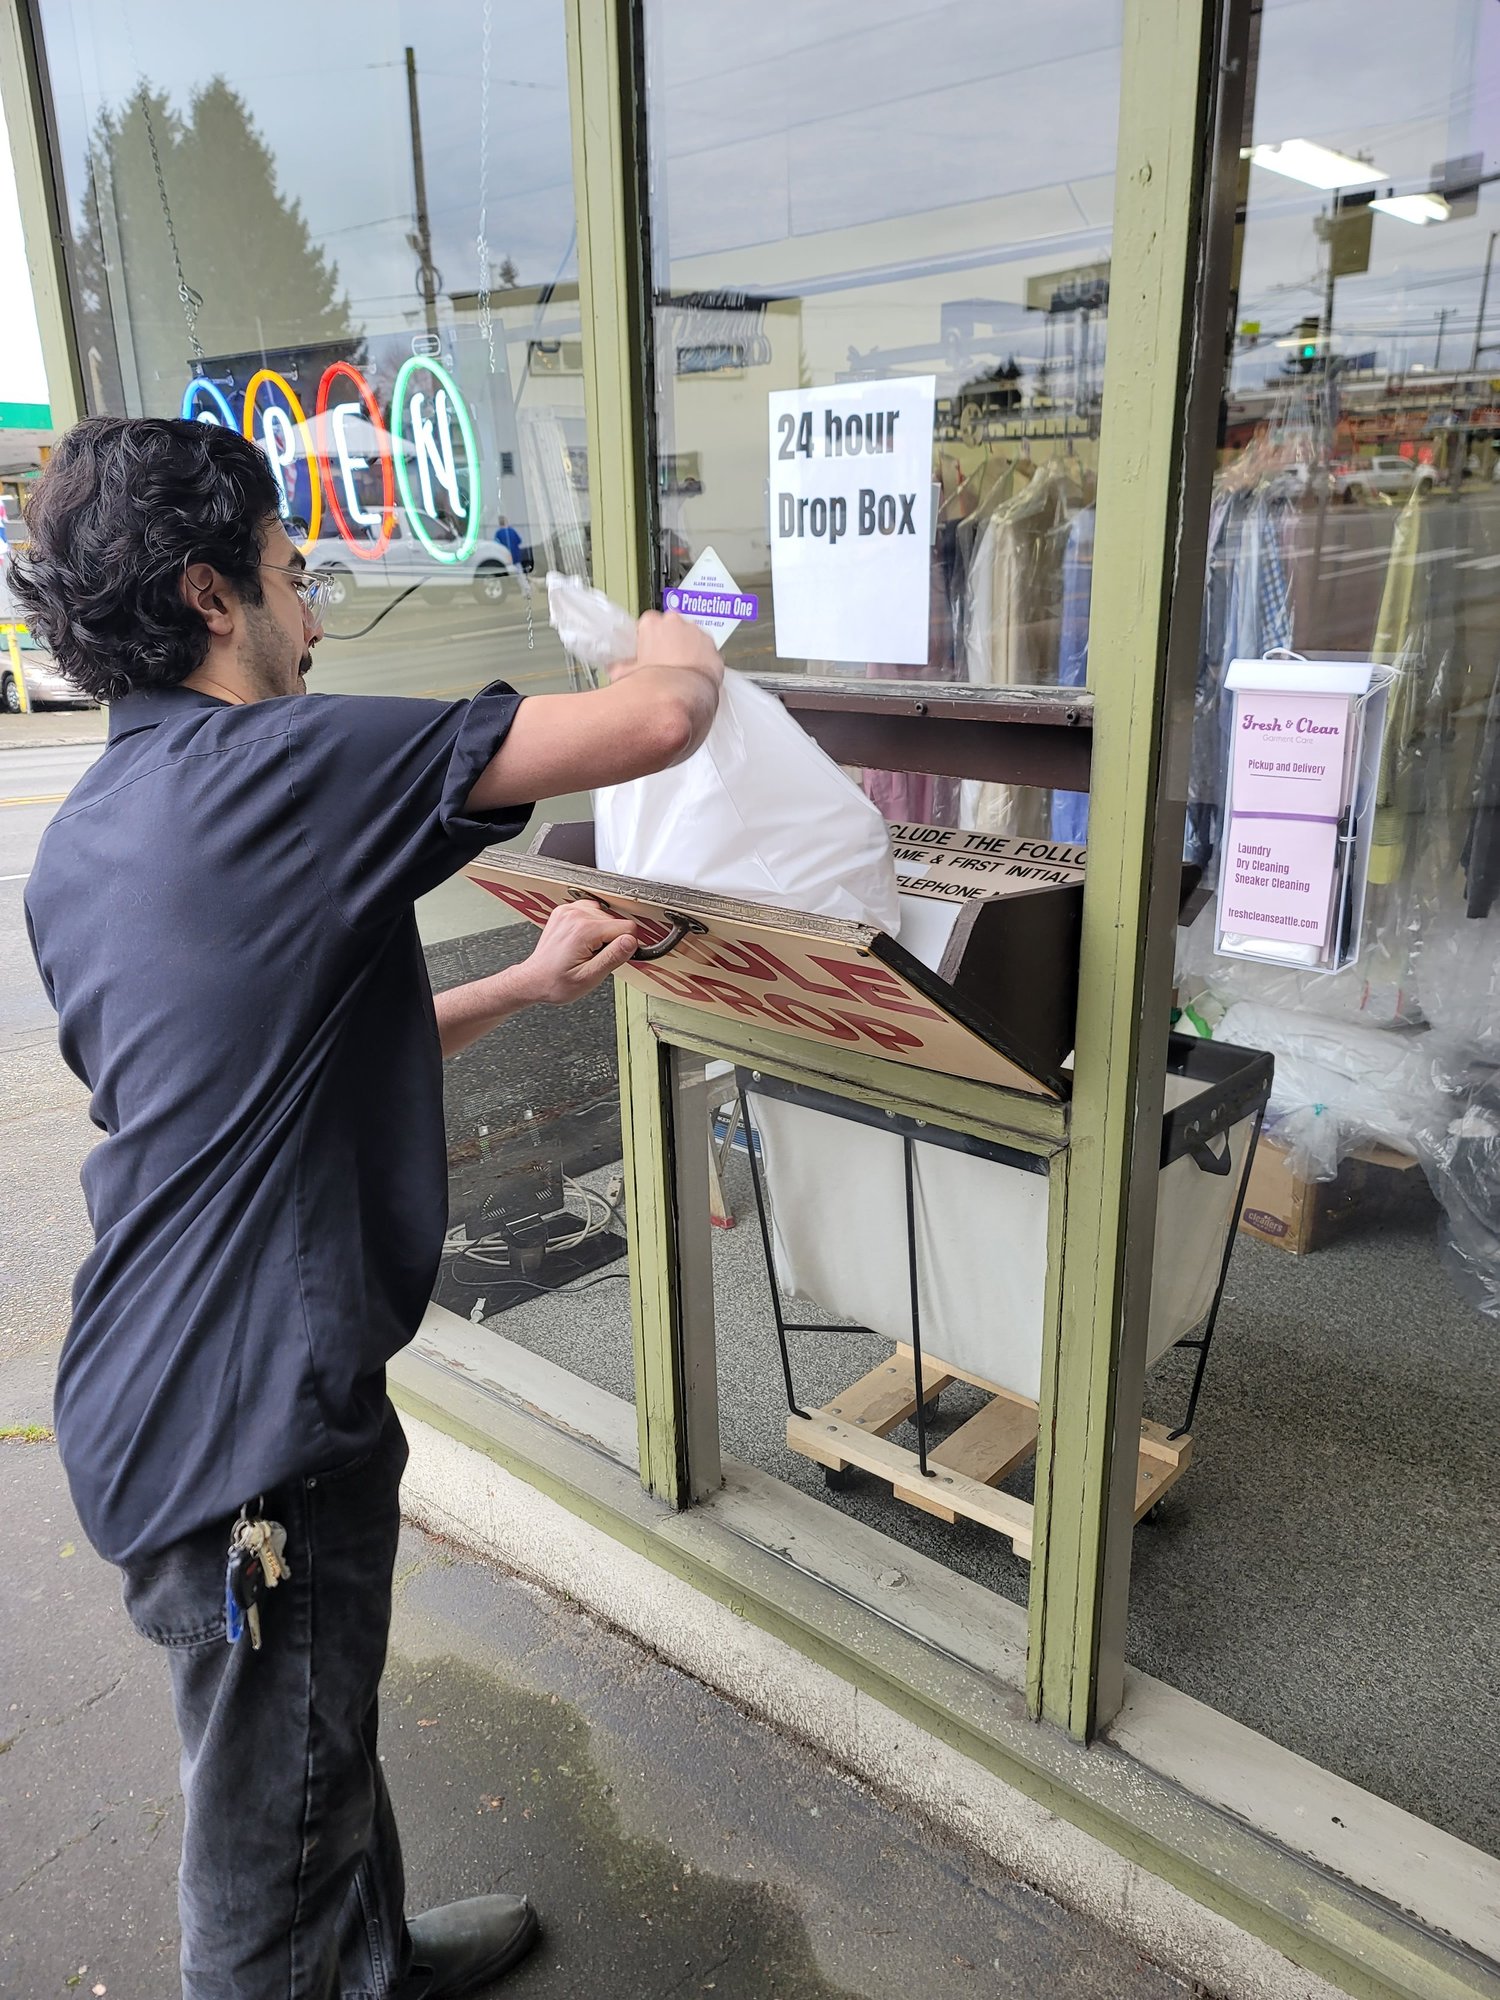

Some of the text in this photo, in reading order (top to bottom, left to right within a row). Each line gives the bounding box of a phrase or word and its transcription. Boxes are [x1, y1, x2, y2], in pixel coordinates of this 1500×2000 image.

[777, 409, 899, 460] 24 hour
[197, 390, 467, 524] PEN
[778, 488, 917, 544] Drop Box
[681, 593, 754, 617] Protection One
[1242, 714, 1340, 735] Fresh & Clean
[1248, 759, 1326, 776] Pickup and Delivery
[963, 834, 1011, 853] THE
[1238, 842, 1272, 858] Laundry
[930, 854, 945, 864] &
[948, 856, 1005, 873] FIRST
[1004, 865, 1070, 884] INITIAL
[1236, 858, 1290, 875] Dry Cleaning
[1234, 873, 1310, 893] Sneaker Cleaning
[1228, 907, 1319, 930] freshcleanseattle.com
[627, 960, 924, 1055] DROP
